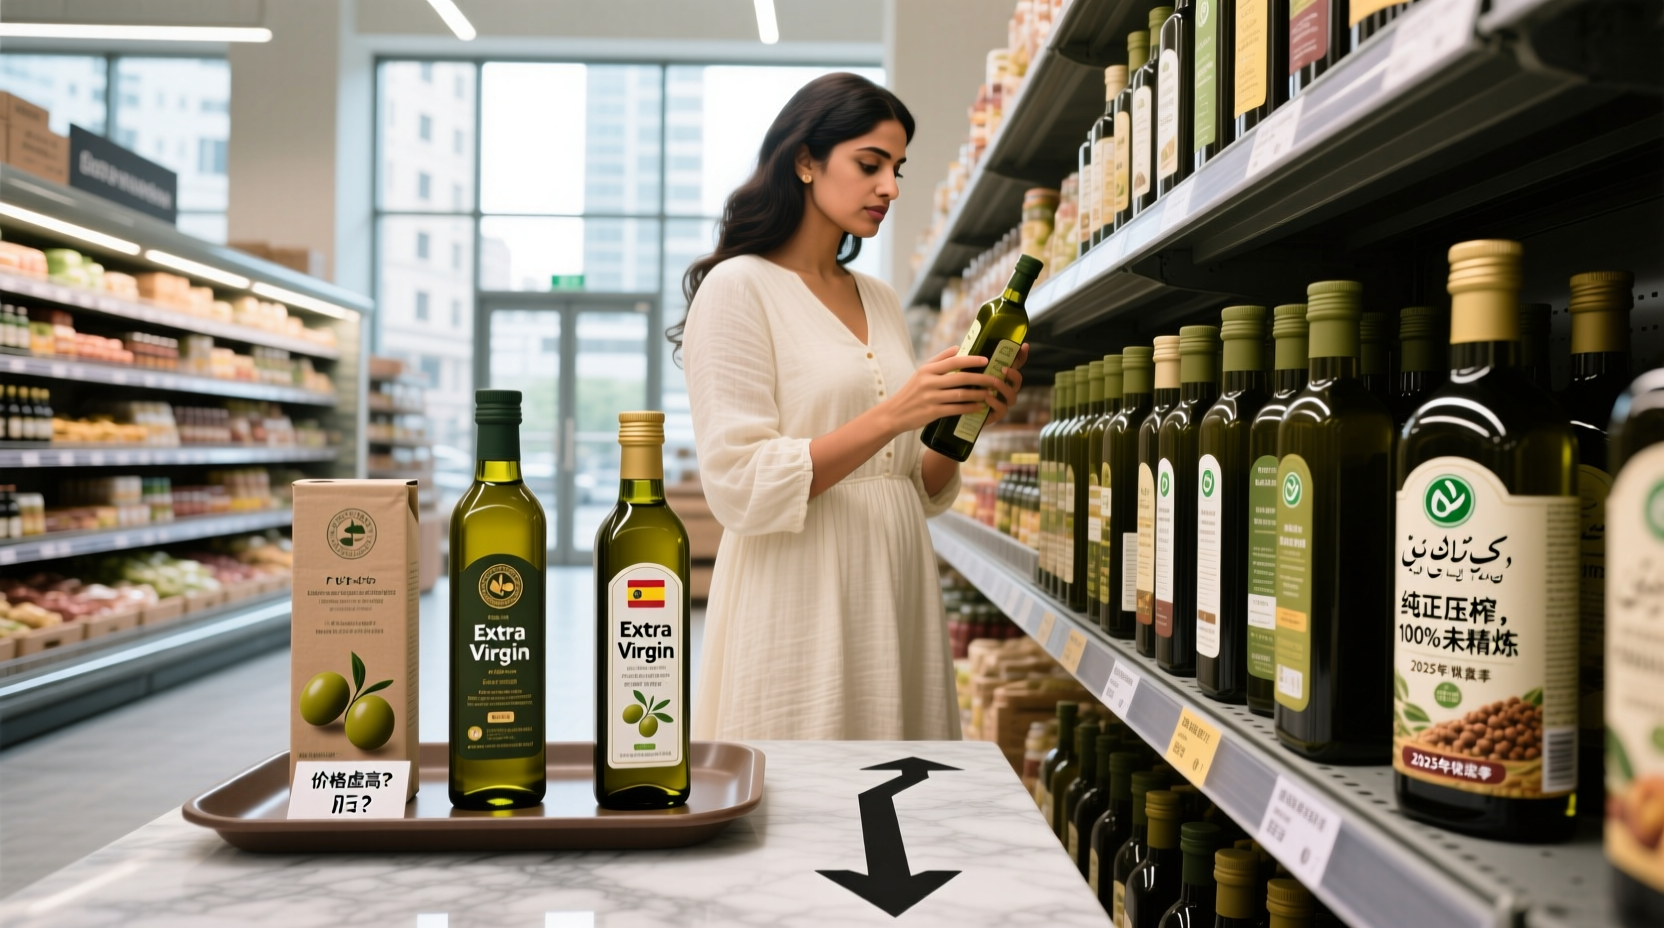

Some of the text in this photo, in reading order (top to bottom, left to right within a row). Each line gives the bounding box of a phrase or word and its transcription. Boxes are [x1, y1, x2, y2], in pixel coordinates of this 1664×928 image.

[474, 624, 526, 642] Extra
[620, 621, 672, 638] Extra
[1399, 623, 1519, 658] 100%未精炼
[469, 642, 530, 666] Virgin
[617, 641, 674, 663] Virgin
[311, 770, 393, 790] 价格虚高?
